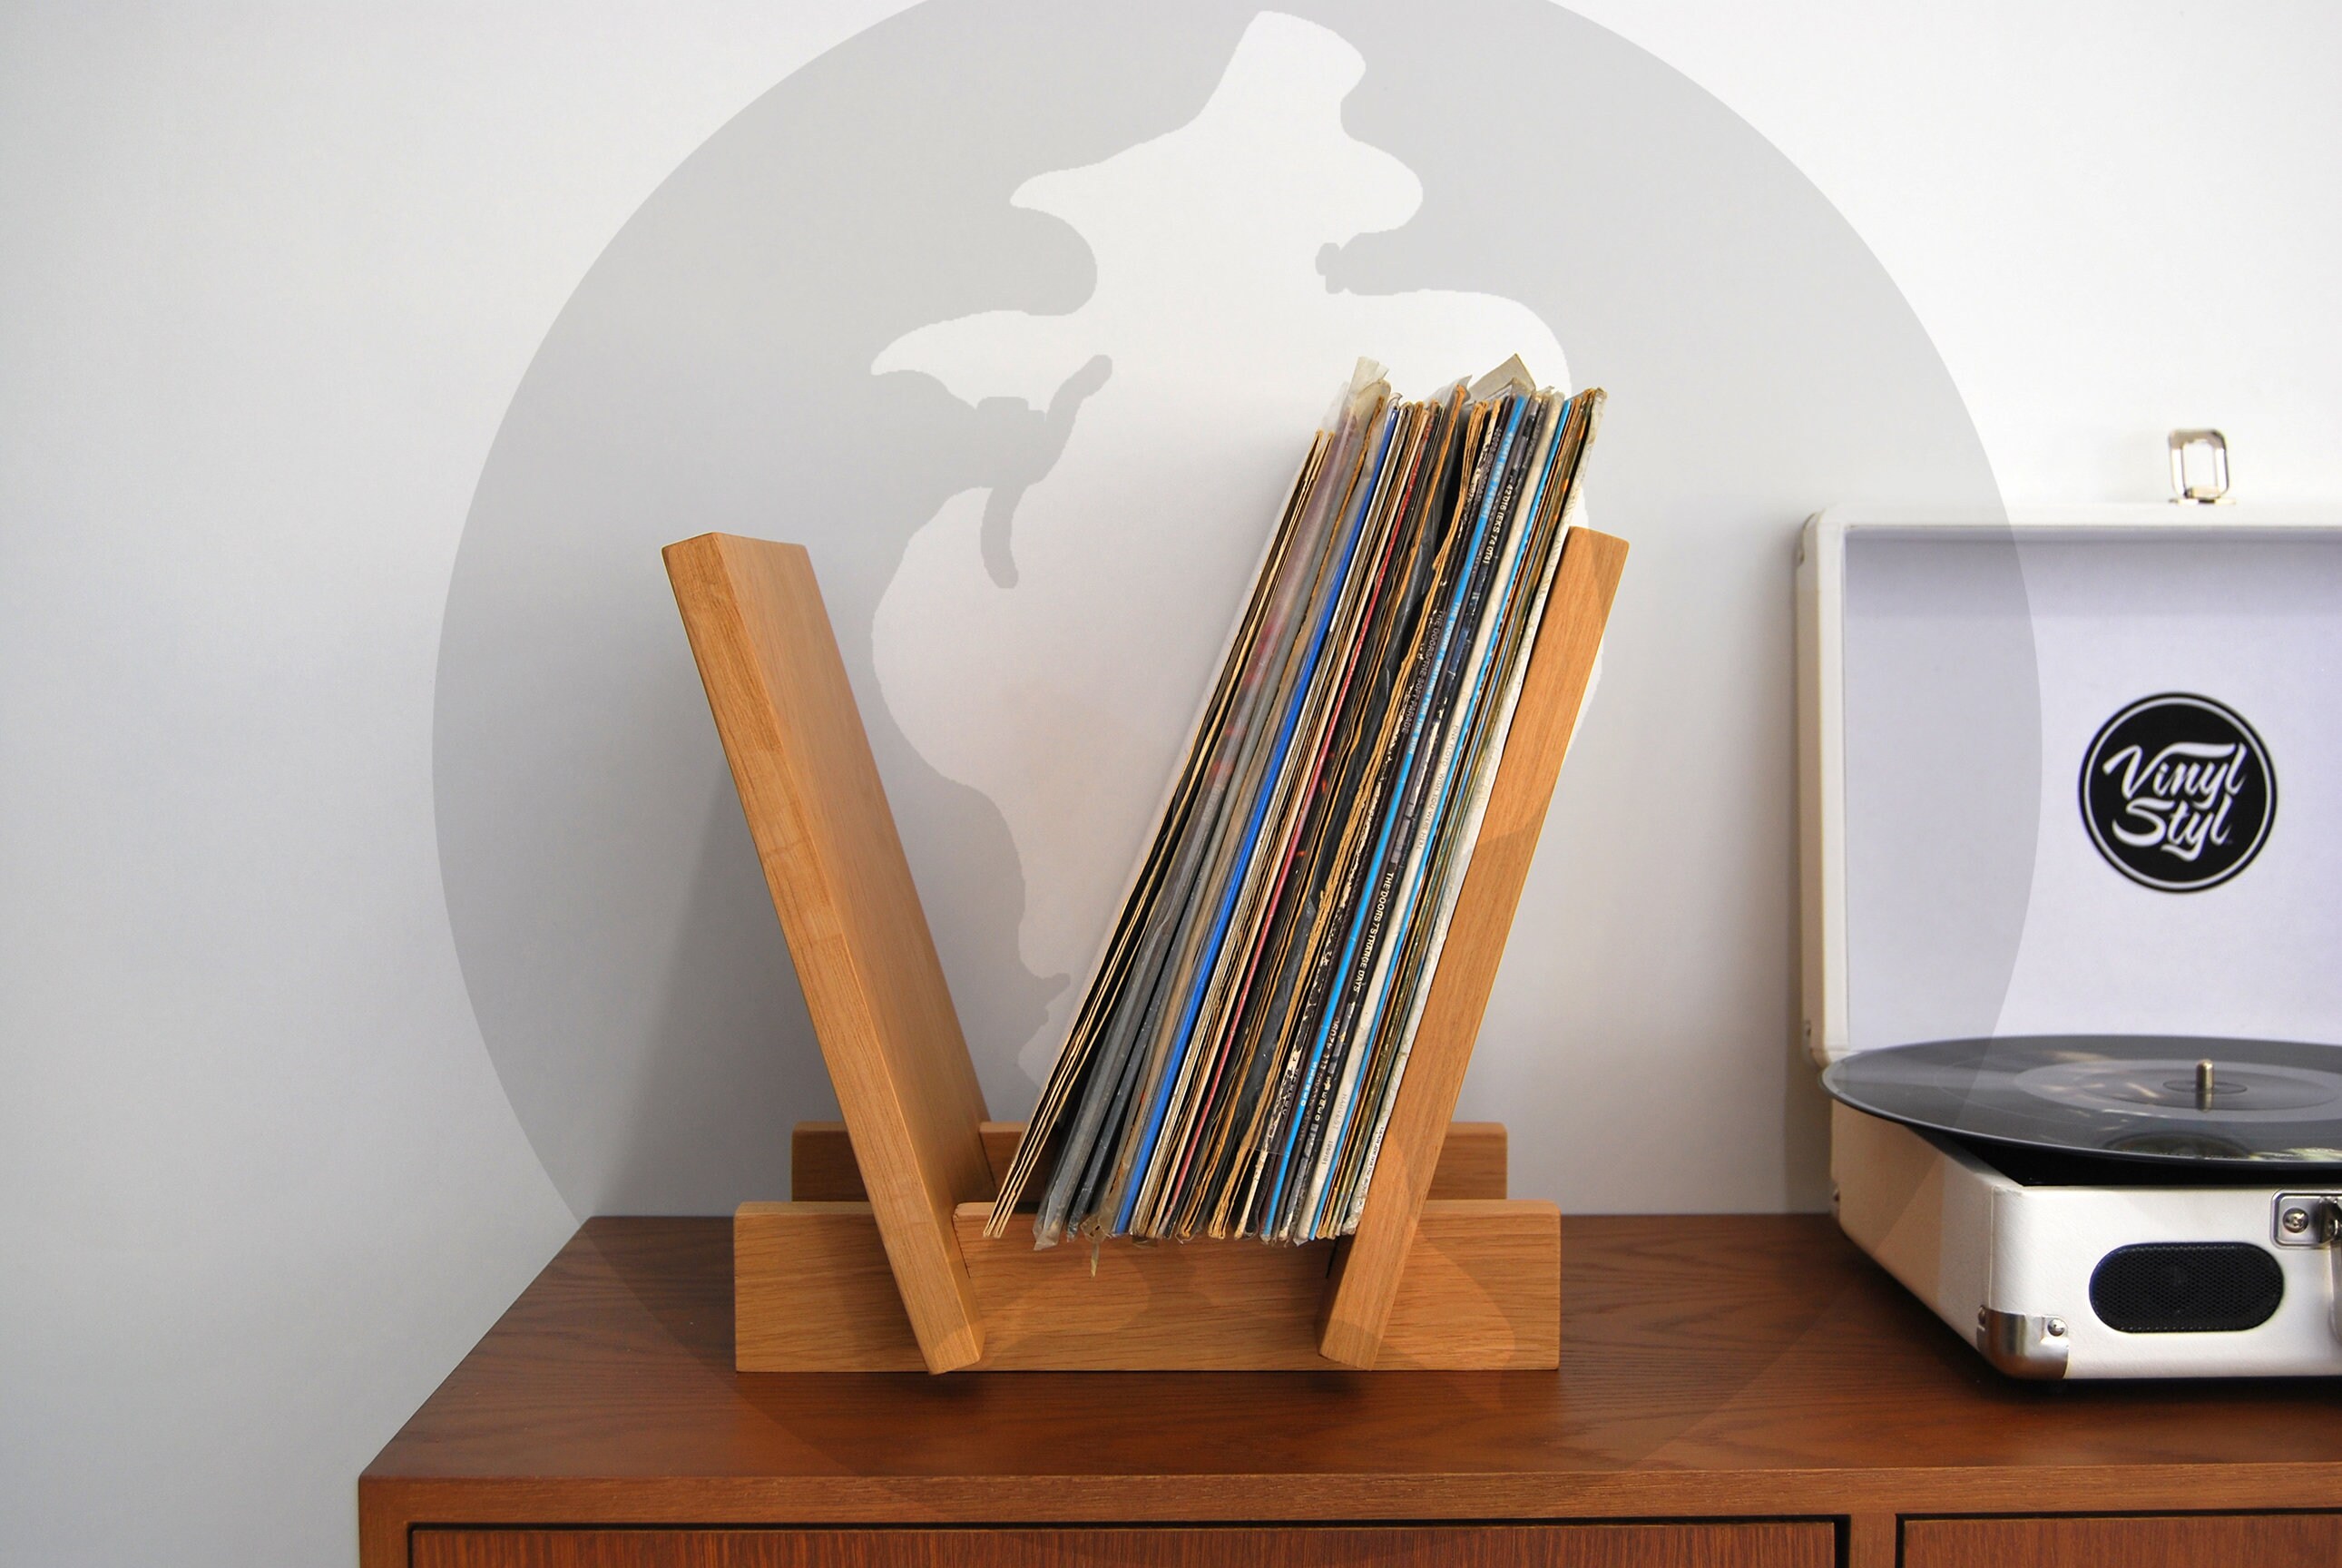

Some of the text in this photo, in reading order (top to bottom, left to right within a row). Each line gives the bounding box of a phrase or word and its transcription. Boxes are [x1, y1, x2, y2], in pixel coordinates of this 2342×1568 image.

[1492, 511, 1504, 533] (EKS
[1488, 534, 1497, 545] 74
[1440, 620, 1455, 651] DOORS
[1411, 676, 1425, 700] SOFT
[1401, 700, 1417, 734] PARADE
[1413, 718, 1424, 734] THE
[1406, 736, 1418, 754] SUN
[1441, 742, 1453, 766] FLOYD
[1434, 772, 1445, 791] WISH
[2102, 741, 2248, 810] Vinyl
[1422, 810, 1433, 830] WERE
[2112, 792, 2232, 861] Styl
[1416, 831, 1426, 851] HERE
[1382, 870, 1394, 889] THE
[1373, 889, 1388, 922] DOORS
[1359, 926, 1377, 968] STRANGE
[1352, 968, 1366, 993] DAYS
[1298, 1060, 1318, 1107] STEREO
